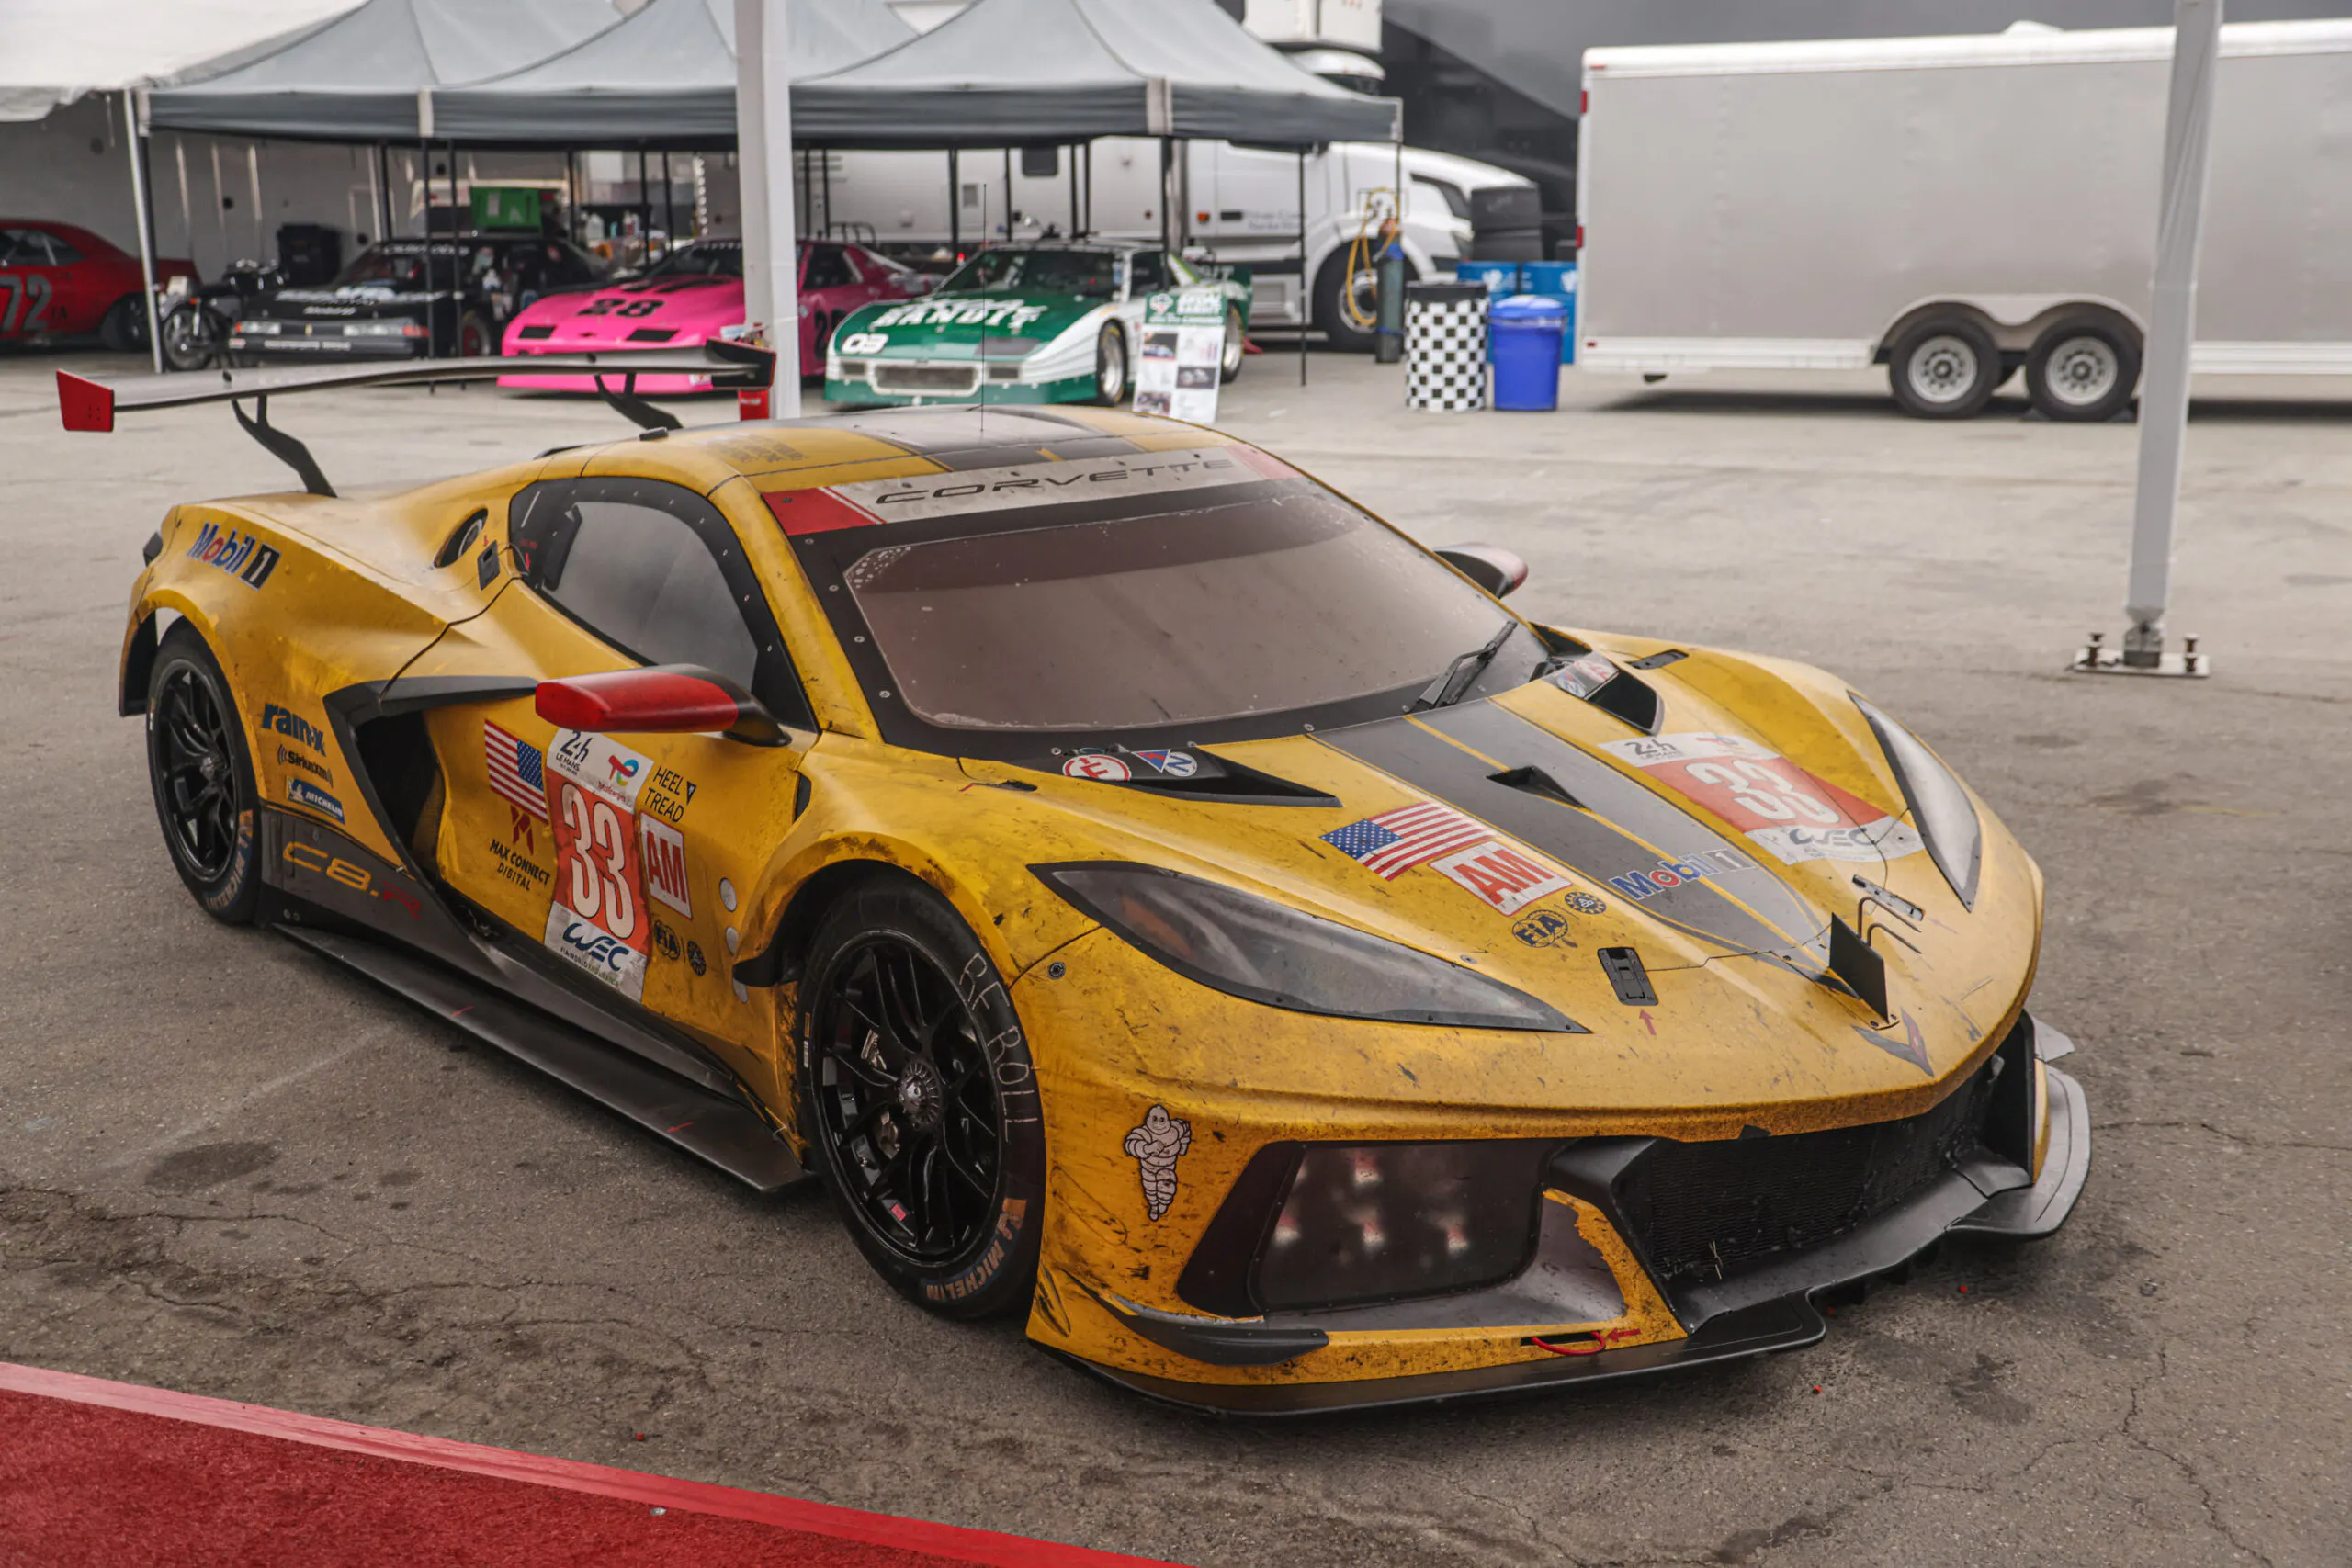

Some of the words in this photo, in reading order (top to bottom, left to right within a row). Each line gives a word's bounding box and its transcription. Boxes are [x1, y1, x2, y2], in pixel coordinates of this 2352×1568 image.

[575, 298, 664, 317] 28
[871, 299, 1048, 334] BANDIT
[876, 458, 1234, 505] CORVETTE
[187, 521, 256, 576] Mobil
[243, 547, 276, 586] 1
[652, 765, 684, 796] HEEL
[1686, 759, 1841, 824] 33
[305, 791, 344, 818] MICHELIN
[644, 787, 685, 823] TREAD
[1790, 827, 1875, 847] WEC
[489, 838, 511, 861] MAX
[510, 852, 551, 886] CONNECT
[497, 862, 531, 892] DIGITAL
[561, 782, 635, 940] 33
[646, 830, 687, 904] AM
[1453, 848, 1555, 905] AM
[1609, 853, 1722, 900] Mobil
[562, 923, 630, 972] WEC
[959, 952, 1011, 1010] RE
[987, 1024, 1039, 1143] ROLL
[926, 1239, 1005, 1301] MICHELIN
